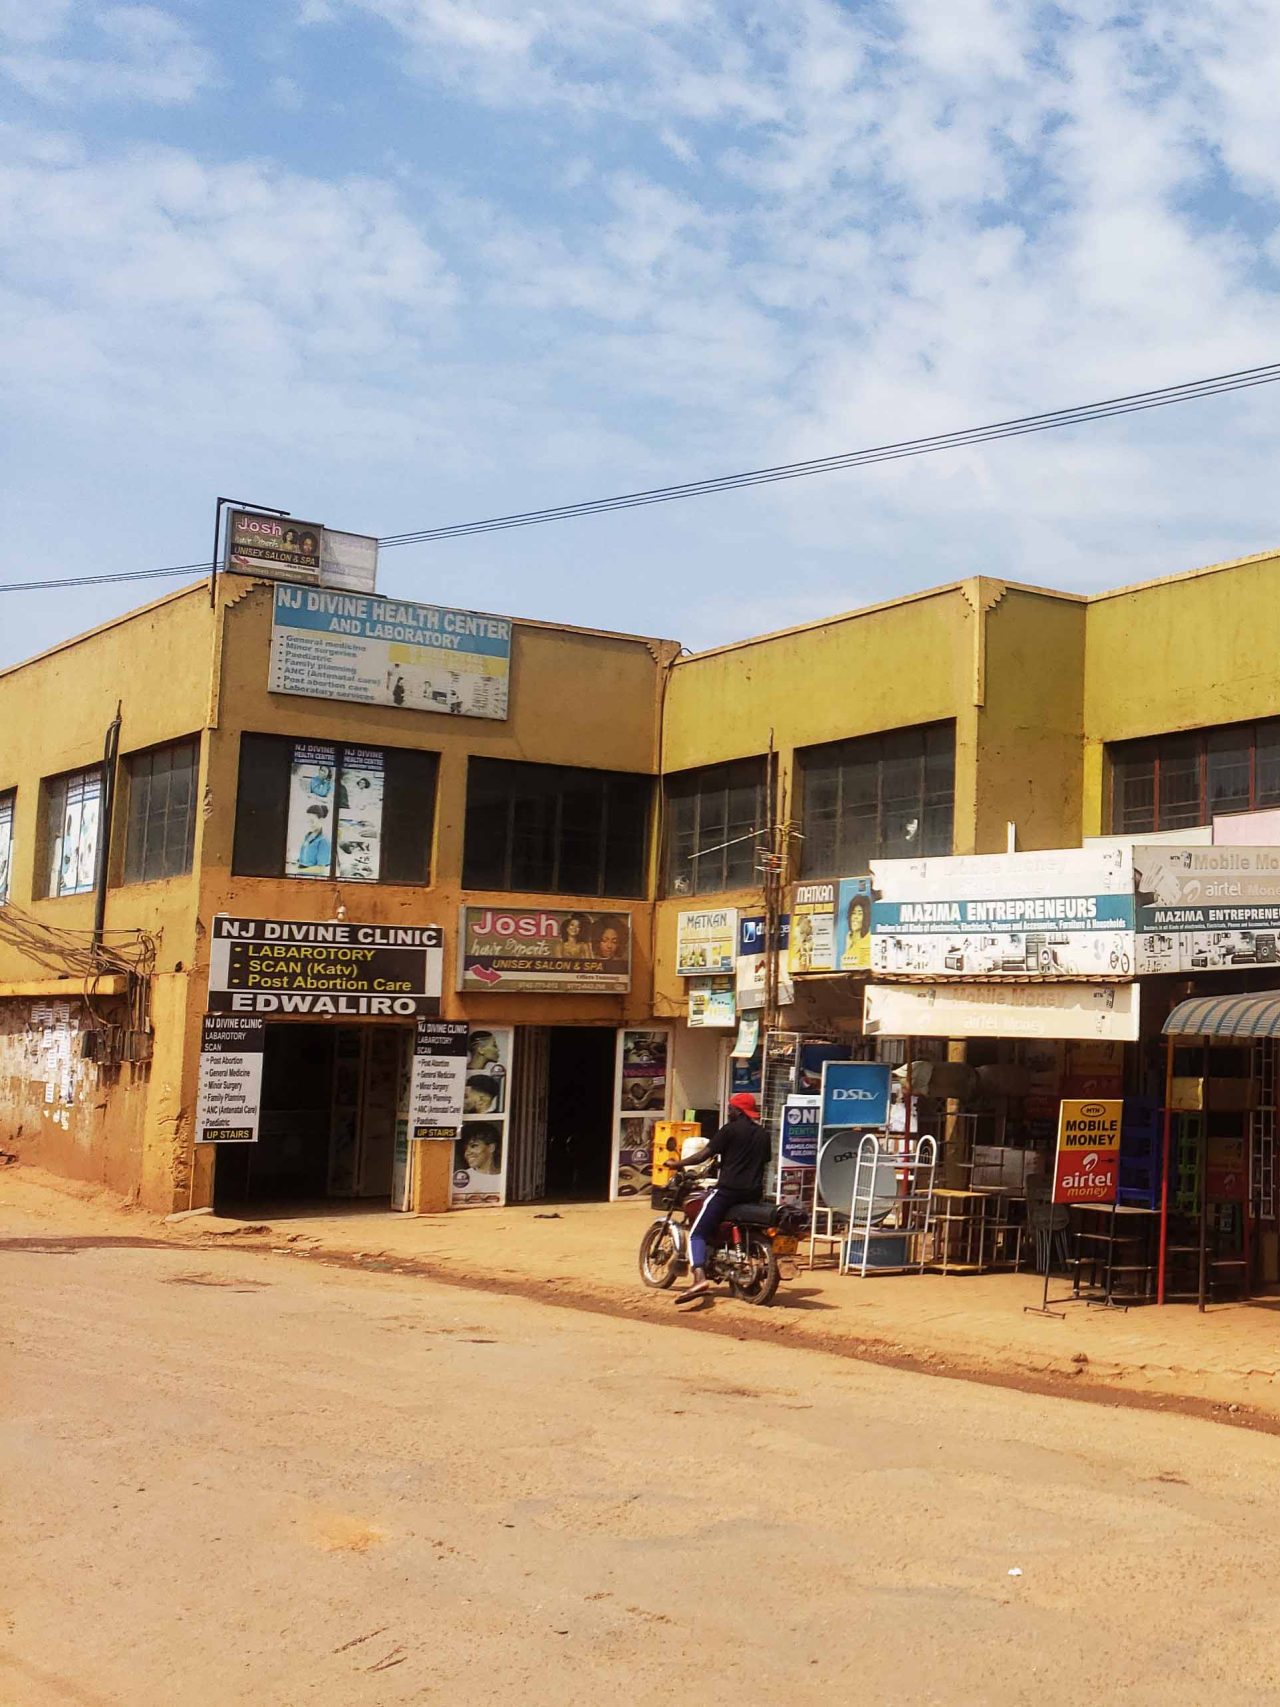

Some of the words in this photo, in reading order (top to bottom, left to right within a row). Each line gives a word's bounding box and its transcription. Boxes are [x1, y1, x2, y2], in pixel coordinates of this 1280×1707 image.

[236, 517, 283, 537] Josh
[234, 546, 264, 558] UNISEX
[265, 551, 291, 563] SALON
[299, 557, 316, 566] SPA
[277, 587, 302, 609] NJ
[307, 591, 368, 619] DIVINE
[372, 601, 439, 630] HEALTH
[443, 613, 509, 641] CENTER
[329, 616, 362, 635] AND
[365, 622, 460, 649] LABORATORY
[286, 634, 323, 646] General
[324, 641, 366, 652] medicine
[286, 642, 312, 652] Minor
[314, 645, 357, 658] surgeries
[284, 666, 305, 676] ANC
[285, 658, 315, 670] Family
[317, 664, 357, 675] planning
[283, 674, 305, 684] Post
[306, 677, 347, 689] abortion
[294, 751, 314, 759] HEALTH
[295, 743, 306, 752] NJ
[307, 744, 335, 755] DIVINE
[344, 748, 355, 756] NJ
[356, 749, 384, 759] DIVINE
[1194, 854, 1251, 871] Mobile
[796, 884, 834, 903] MATKAN
[1205, 880, 1243, 898] airtel
[900, 903, 962, 923] MAZIMA
[966, 898, 1097, 921] ENTREPRENEURS
[1154, 910, 1205, 924] MAZIMA
[472, 909, 561, 938] Josh
[686, 913, 728, 929] MATKAN
[221, 920, 256, 938] NJ
[264, 923, 351, 943] DIVINE
[357, 927, 438, 945] CLINIC
[249, 945, 376, 961] LABAROTORY
[249, 960, 301, 974] SCAN
[306, 963, 359, 978] (Katv)
[492, 959, 533, 970] UNISEX
[534, 961, 571, 971] SALON
[573, 962, 580, 970] &
[583, 962, 604, 971] SPA
[248, 974, 289, 988] Post
[292, 975, 368, 991] Abortion
[372, 978, 412, 991] Care
[231, 993, 418, 1016] EDWALIRO
[205, 1018, 215, 1029] NJ
[216, 1018, 239, 1029] DIVINE
[239, 1019, 263, 1029] CLINIC
[417, 1023, 426, 1033] NJ
[426, 1023, 447, 1034] DIVINE
[447, 1024, 468, 1034] CLINIC
[205, 1031, 247, 1041] LABAROTORY
[417, 1036, 453, 1045] LABAROTORY
[204, 1043, 222, 1052] SCAN
[417, 1046, 432, 1055] SCAN
[209, 1056, 222, 1065] Post
[222, 1056, 243, 1065] Abortion
[209, 1068, 229, 1078] General
[229, 1068, 251, 1078] Medicine
[208, 1081, 221, 1090] Minor
[221, 1081, 242, 1092] Surgery
[206, 1093, 224, 1104] Family
[224, 1093, 246, 1104] Planning
[206, 1105, 218, 1115] ANC
[218, 1105, 244, 1116] (Antenatal
[244, 1105, 257, 1116] Care)
[1087, 1107, 1100, 1115] MTN
[1065, 1119, 1118, 1132] MOBILE
[206, 1131, 219, 1140] UP
[220, 1130, 250, 1140] STAIRS
[417, 1128, 428, 1137] UP
[429, 1128, 457, 1137] STAIRS
[1065, 1134, 1116, 1146] MONEY
[1061, 1171, 1113, 1188] airtel
[1066, 1186, 1108, 1198] money
